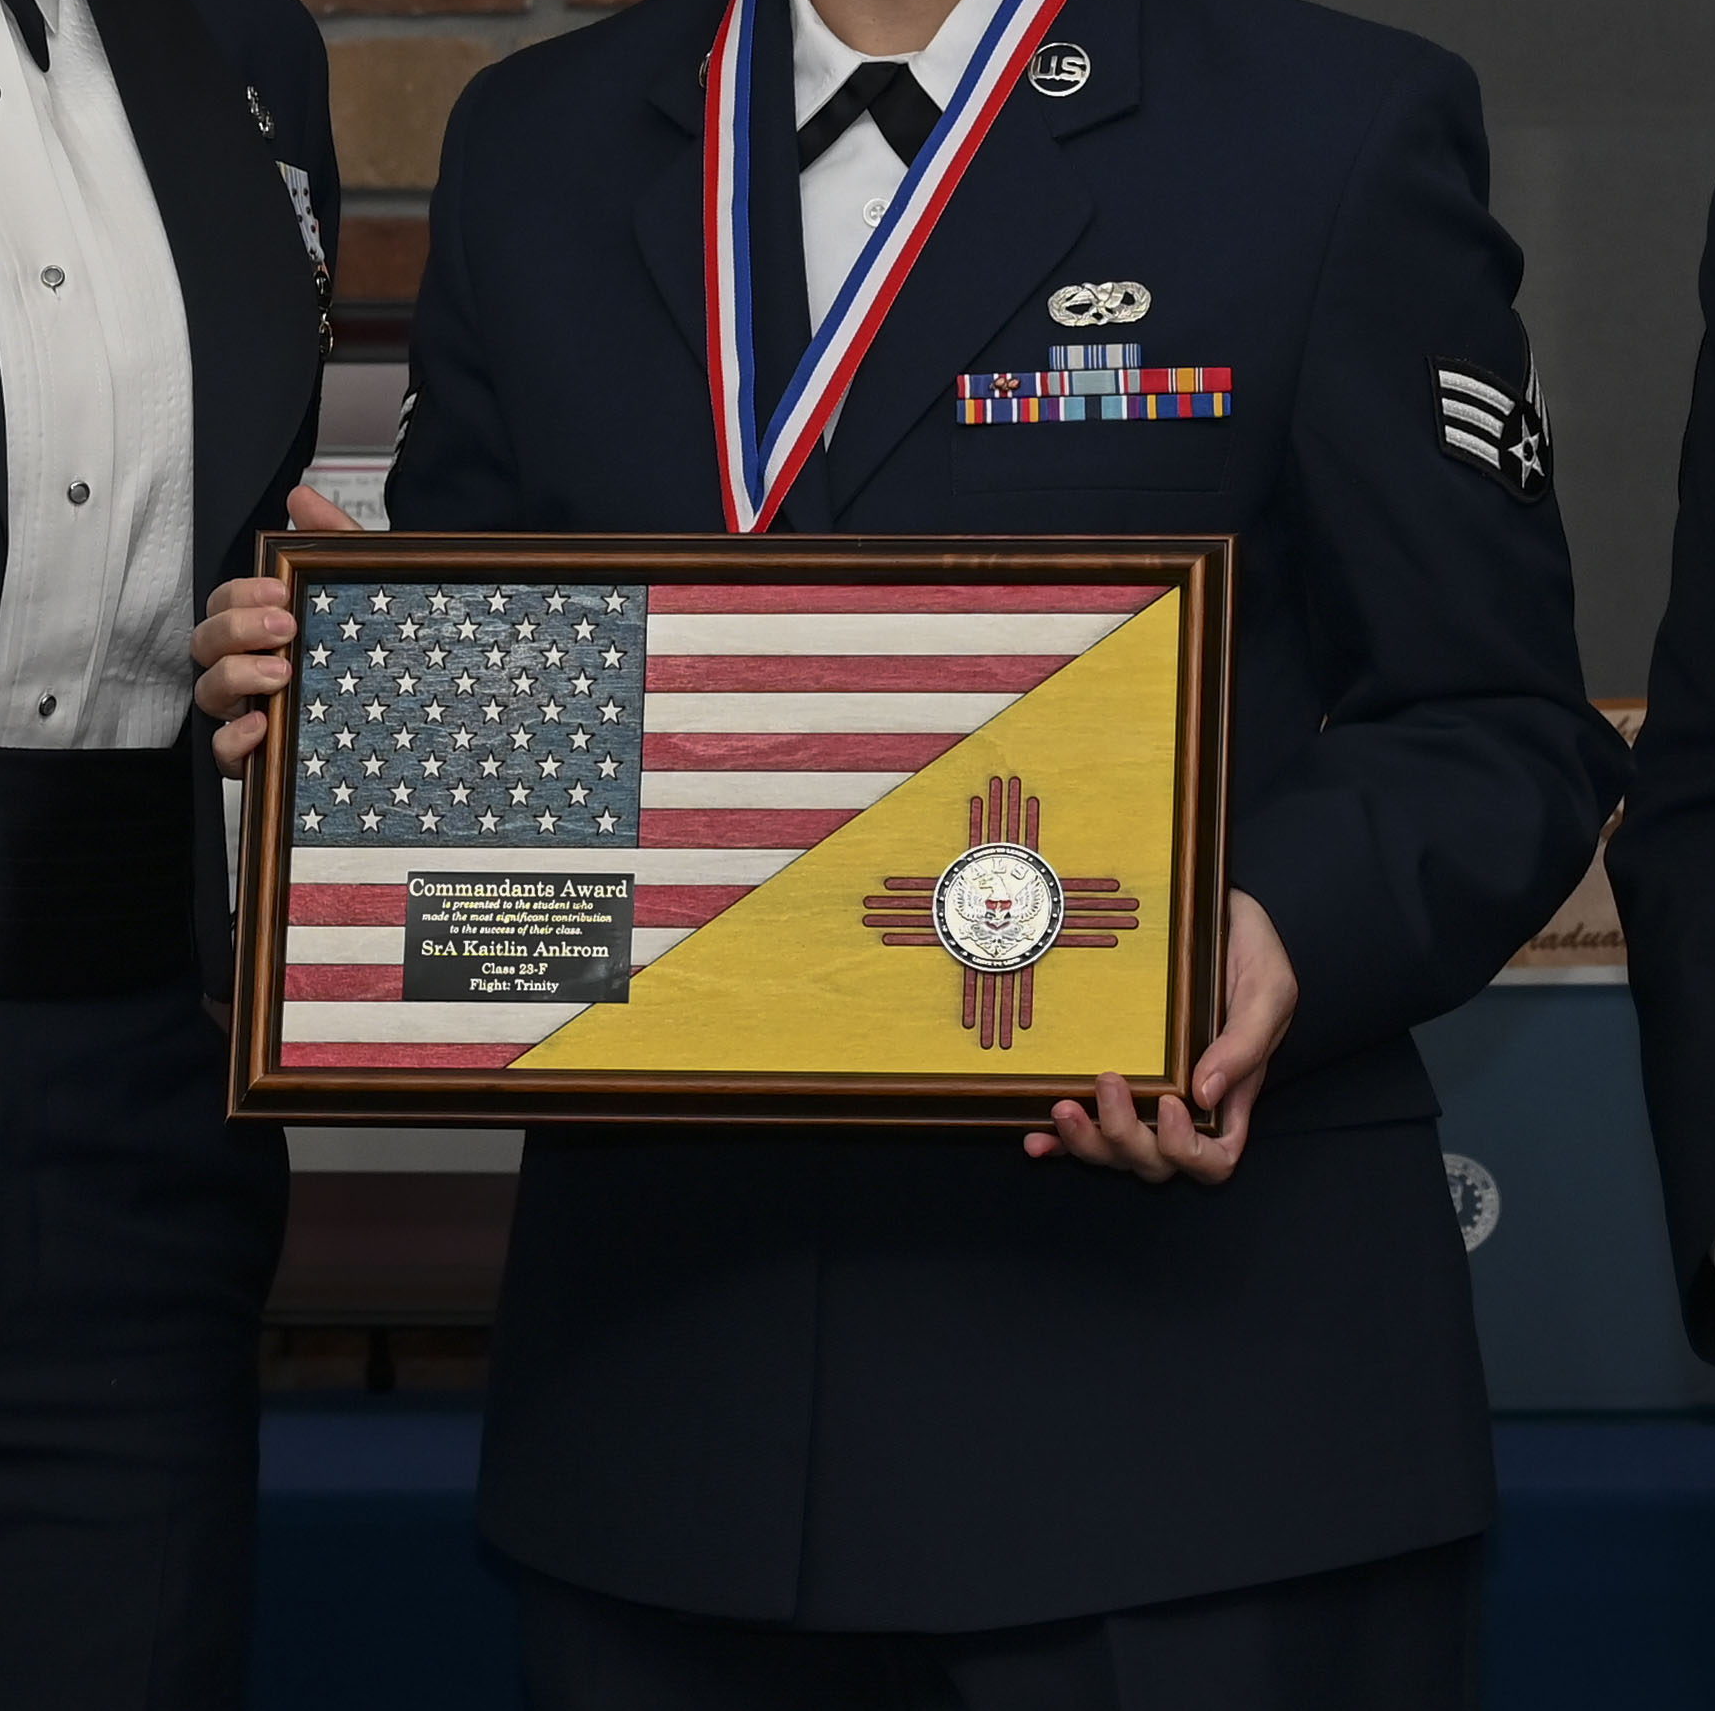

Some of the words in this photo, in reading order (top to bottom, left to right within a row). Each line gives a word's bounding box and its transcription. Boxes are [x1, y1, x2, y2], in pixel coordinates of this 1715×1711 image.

[409, 877, 555, 897] Commandants
[560, 879, 628, 898] Award
[442, 898, 451, 909] is
[452, 898, 501, 911] presented
[502, 899, 512, 909] to
[515, 898, 531, 909] the
[532, 899, 570, 910] student
[572, 899, 594, 910] who
[422, 910, 450, 921] made
[451, 911, 467, 921] the
[469, 912, 494, 921] most
[495, 911, 549, 924] significant
[551, 912, 612, 923] contribution
[449, 924, 459, 934] to
[461, 923, 477, 934] the
[479, 926, 515, 934] success
[517, 924, 529, 936] of
[529, 924, 553, 935] their
[555, 924, 583, 935] class.
[421, 939, 458, 956] SrA
[462, 940, 528, 957] Kaitlin
[533, 941, 609, 958] Ankrom
[481, 962, 515, 974] Class
[469, 978, 511, 993] Flight:
[514, 979, 559, 993] Trinity
